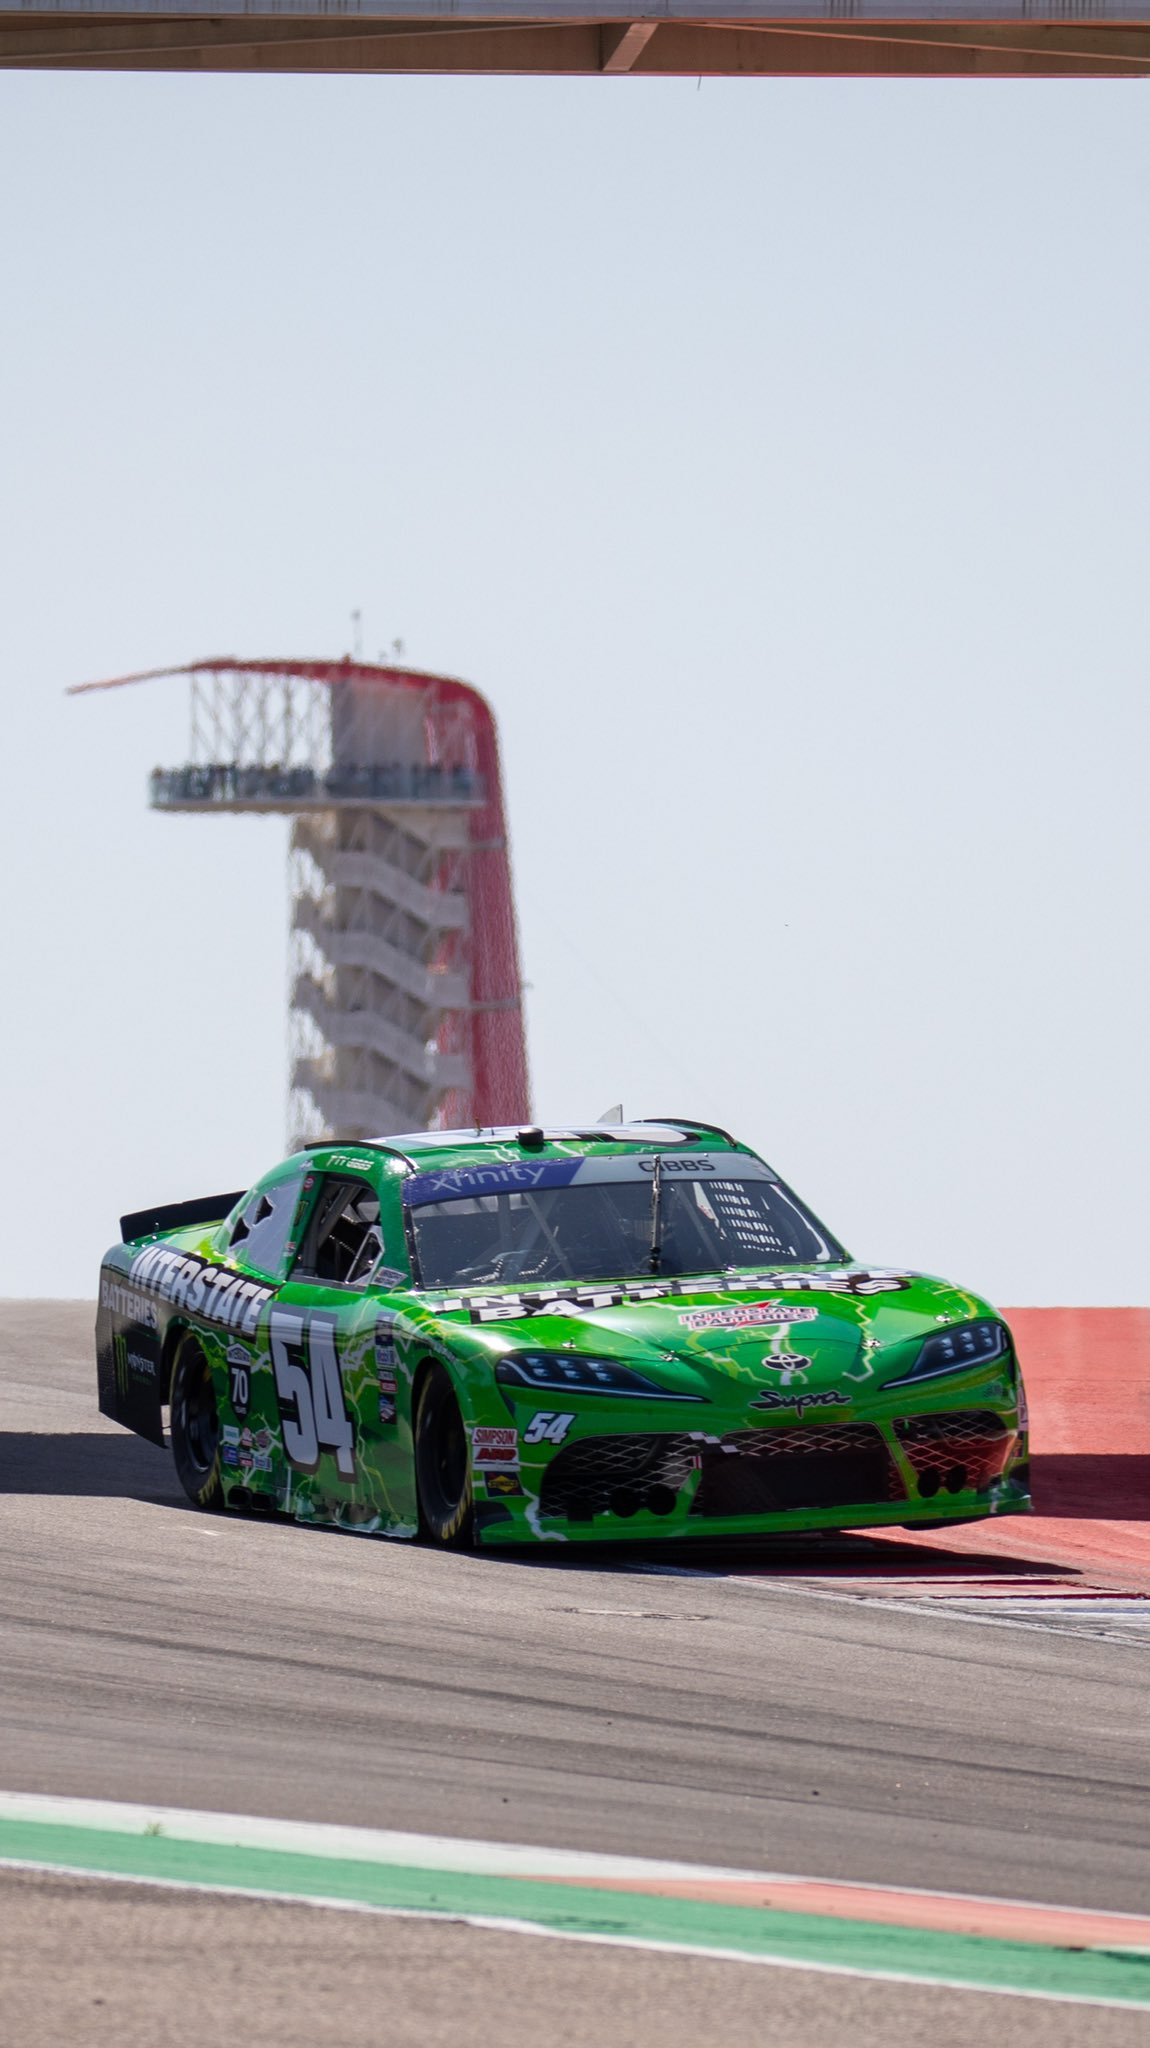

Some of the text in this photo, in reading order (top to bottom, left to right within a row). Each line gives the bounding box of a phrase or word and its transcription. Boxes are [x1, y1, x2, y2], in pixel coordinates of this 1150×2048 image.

[430, 1165, 546, 1193] xfinity
[101, 1279, 159, 1329] BATTERIES
[128, 1245, 274, 1335] INTERSTATE
[443, 1269, 912, 1311] INTERSTATE
[479, 1277, 902, 1322] BATTERIES
[683, 1305, 813, 1323] INTERSTATE
[694, 1313, 811, 1327] BATTERIES
[231, 1367, 249, 1405] 70
[271, 1311, 355, 1474] 54
[750, 1390, 852, 1419] Supra
[474, 1428, 516, 1445] SIMPSON
[523, 1412, 576, 1444] 54
